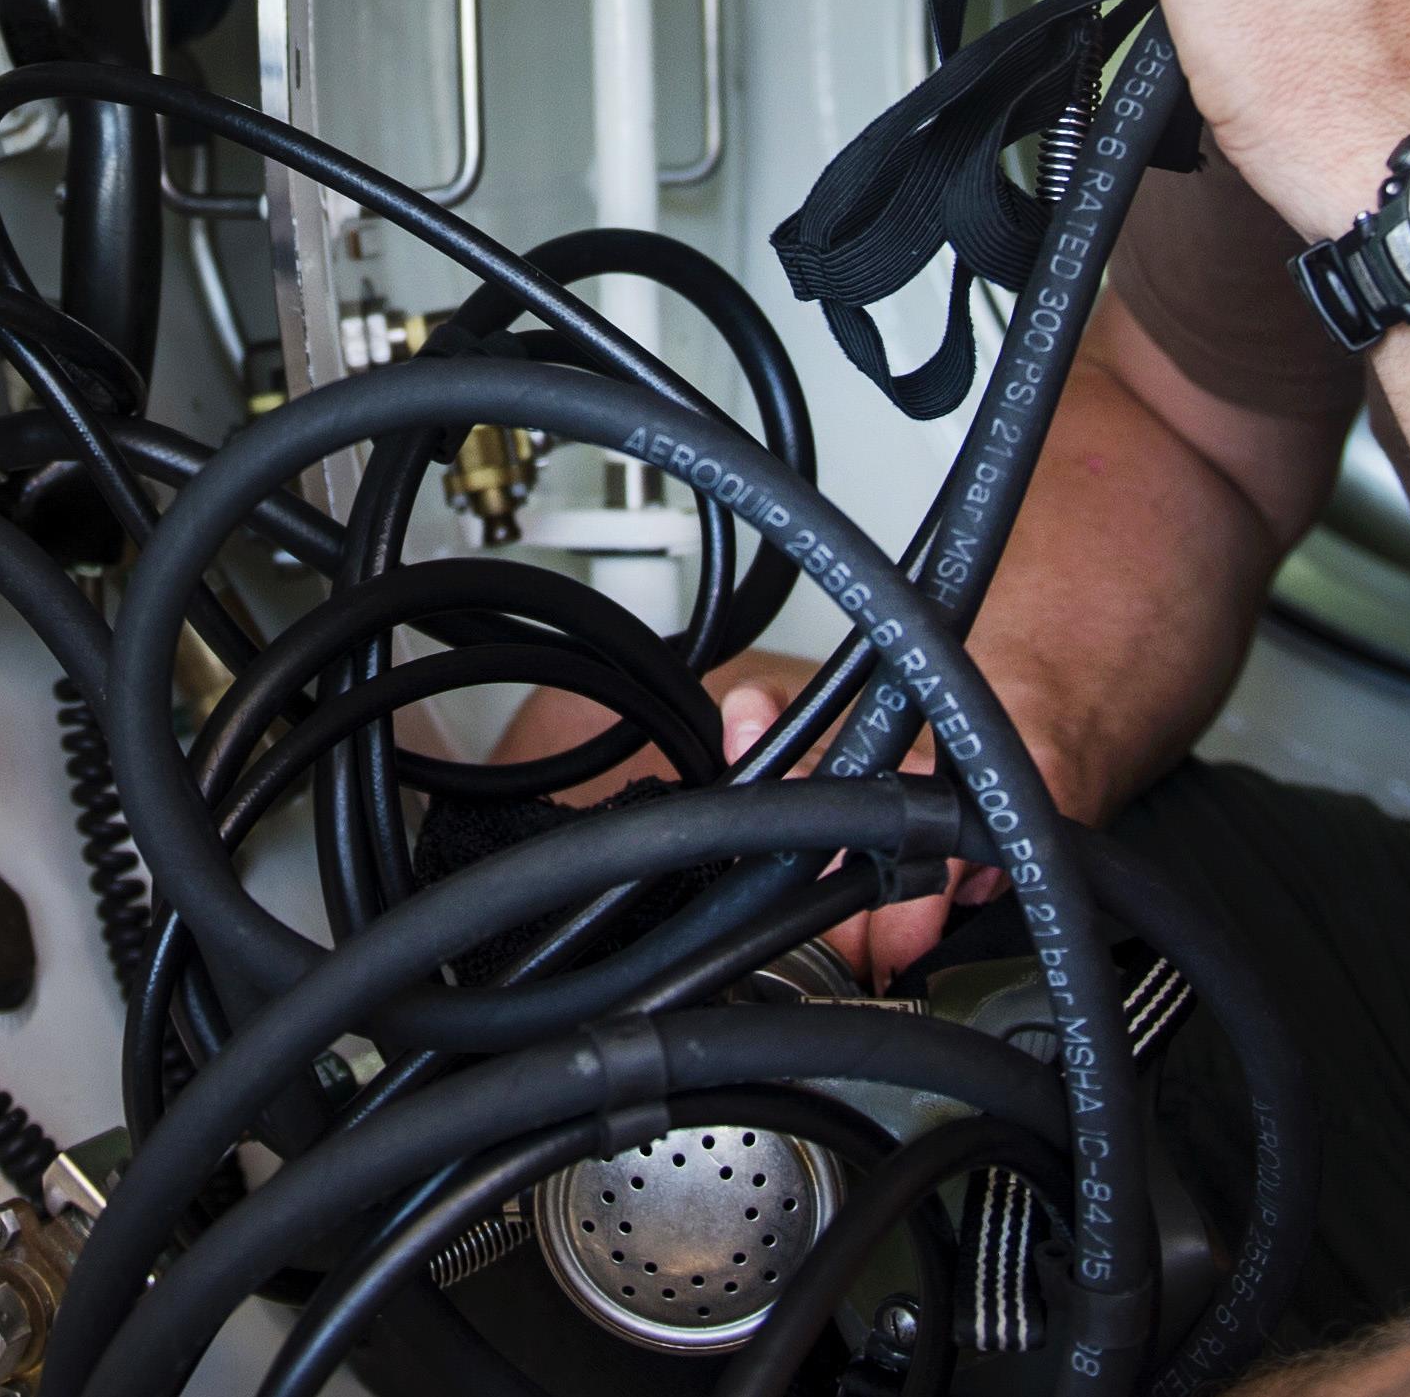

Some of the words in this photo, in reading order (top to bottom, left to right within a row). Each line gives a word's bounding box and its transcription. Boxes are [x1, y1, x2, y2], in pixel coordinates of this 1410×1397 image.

[1096, 37, 1173, 161] 2556-6
[1049, 167, 1116, 280] RATED
[1023, 288, 1069, 353] 300
[1000, 358, 1042, 413] PSI
[985, 418, 1022, 458] 21
[623, 426, 791, 529] AEROQUIP
[963, 462, 1008, 523] bar
[784, 528, 904, 648] 2556-6
[926, 528, 978, 609] MSH
[892, 646, 983, 761] RATED
[967, 767, 1020, 834] 300
[1001, 838, 1048, 893] PSI
[1024, 903, 1063, 938] 21
[1040, 947, 1075, 1006] bar
[1057, 1016, 1107, 1115] MSHA
[1077, 1126, 1113, 1281] IC-84/15
